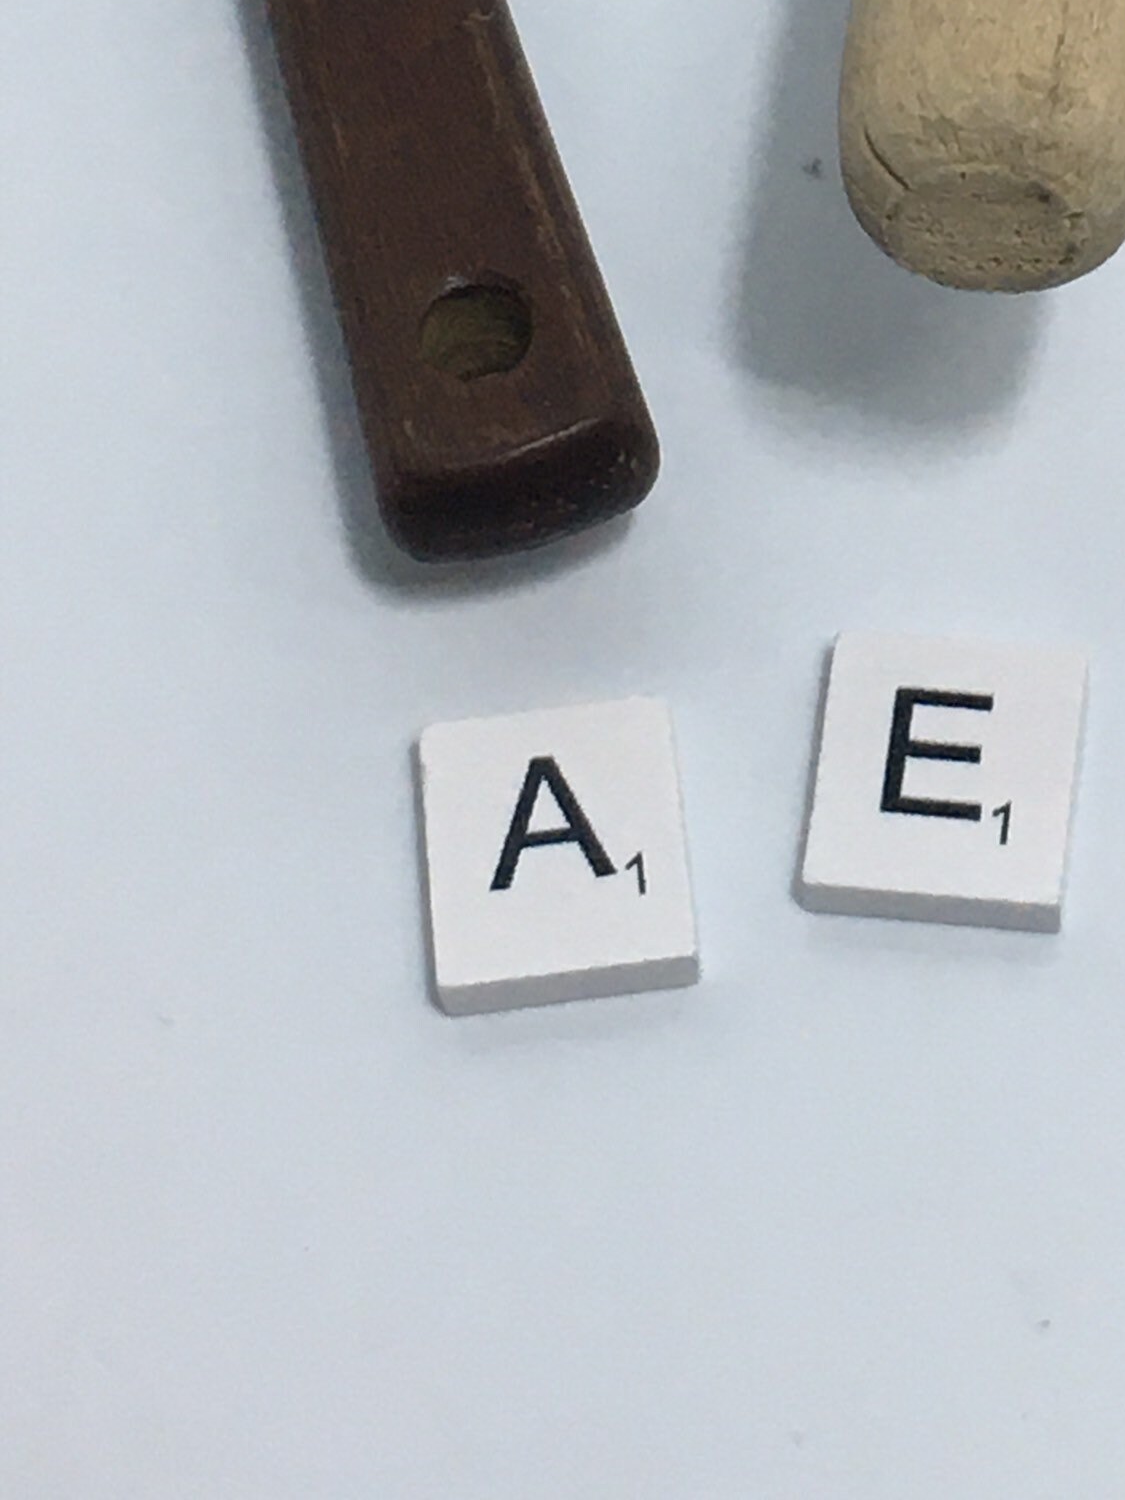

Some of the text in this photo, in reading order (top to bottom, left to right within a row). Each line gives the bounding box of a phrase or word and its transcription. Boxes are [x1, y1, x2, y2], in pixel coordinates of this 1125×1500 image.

[490, 756, 646, 896] A 1
[880, 687, 1012, 846] E 1
